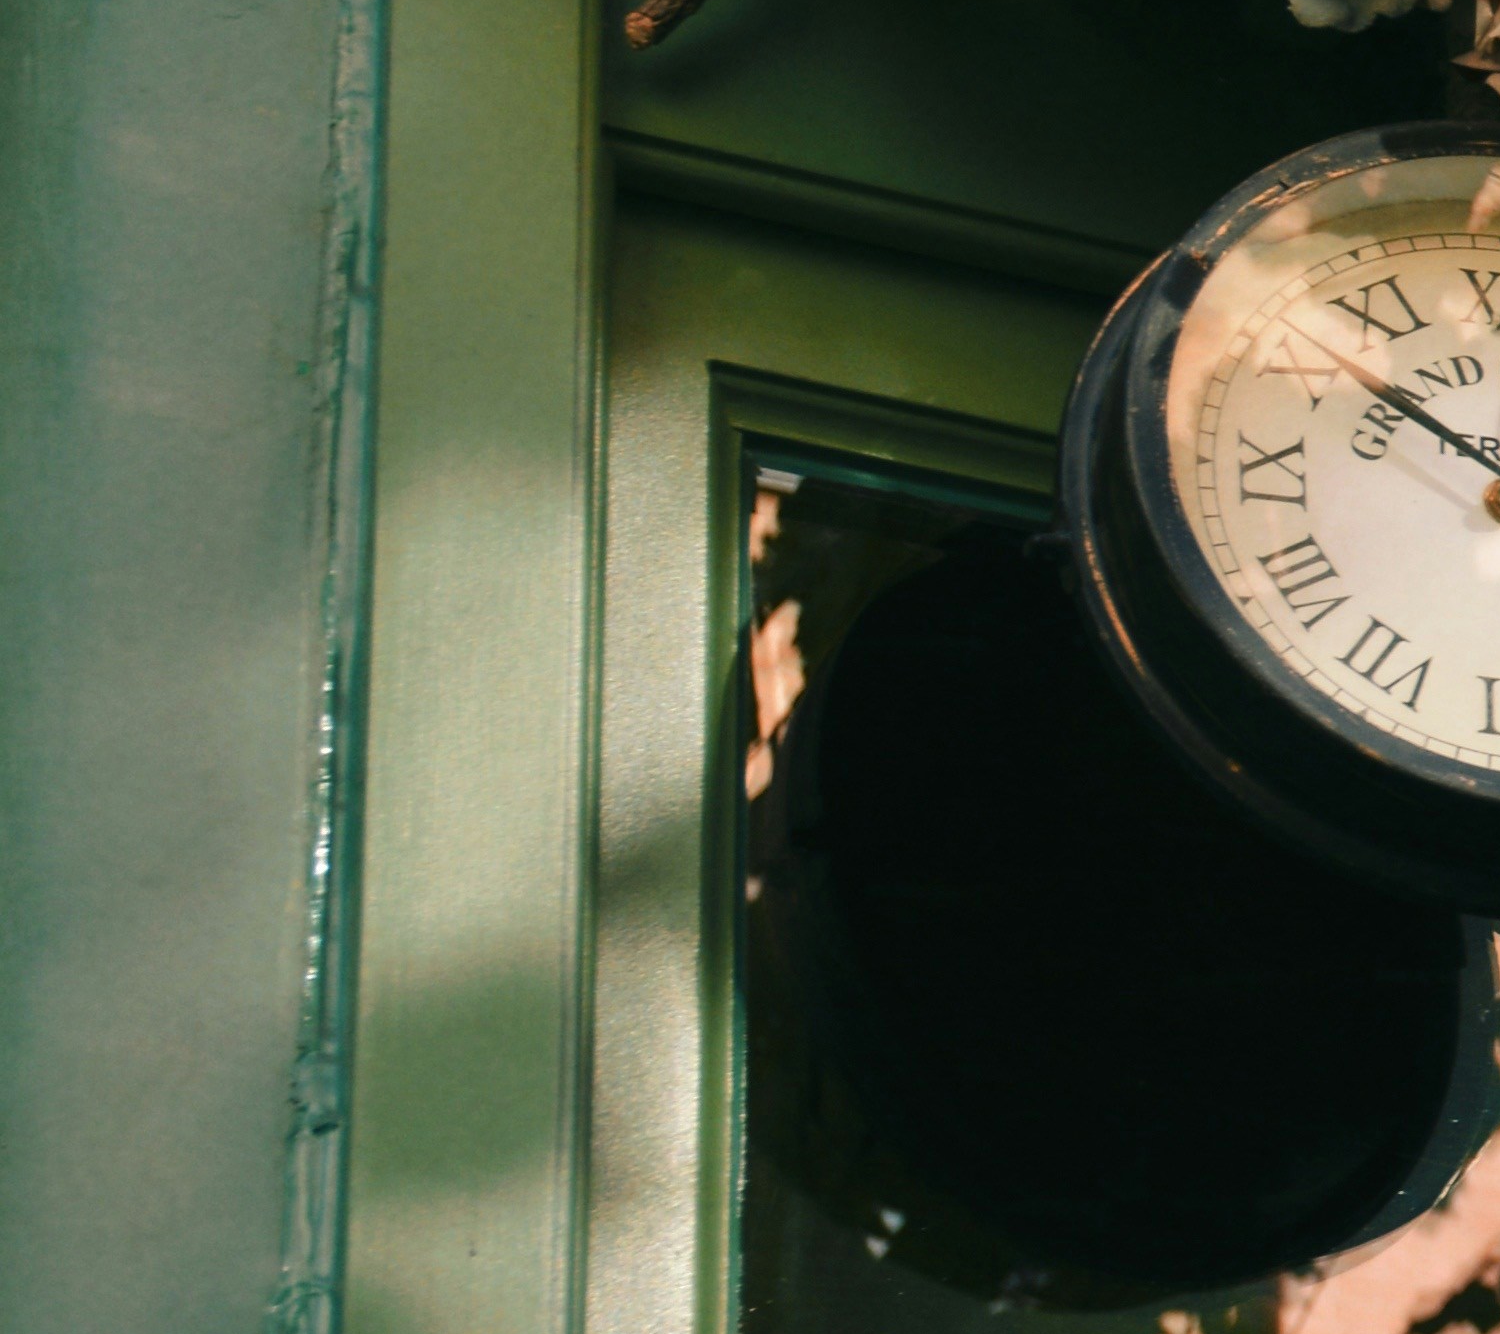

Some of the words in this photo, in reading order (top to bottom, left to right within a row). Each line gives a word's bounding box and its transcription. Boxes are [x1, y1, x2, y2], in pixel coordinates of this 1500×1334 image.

[1328, 274, 1432, 342] XI
[1256, 315, 1340, 411] X
[1350, 353, 1486, 462] GRAND
[1239, 430, 1308, 511] IX
[1256, 533, 1353, 633] VIII
[1335, 614, 1435, 712] VII
